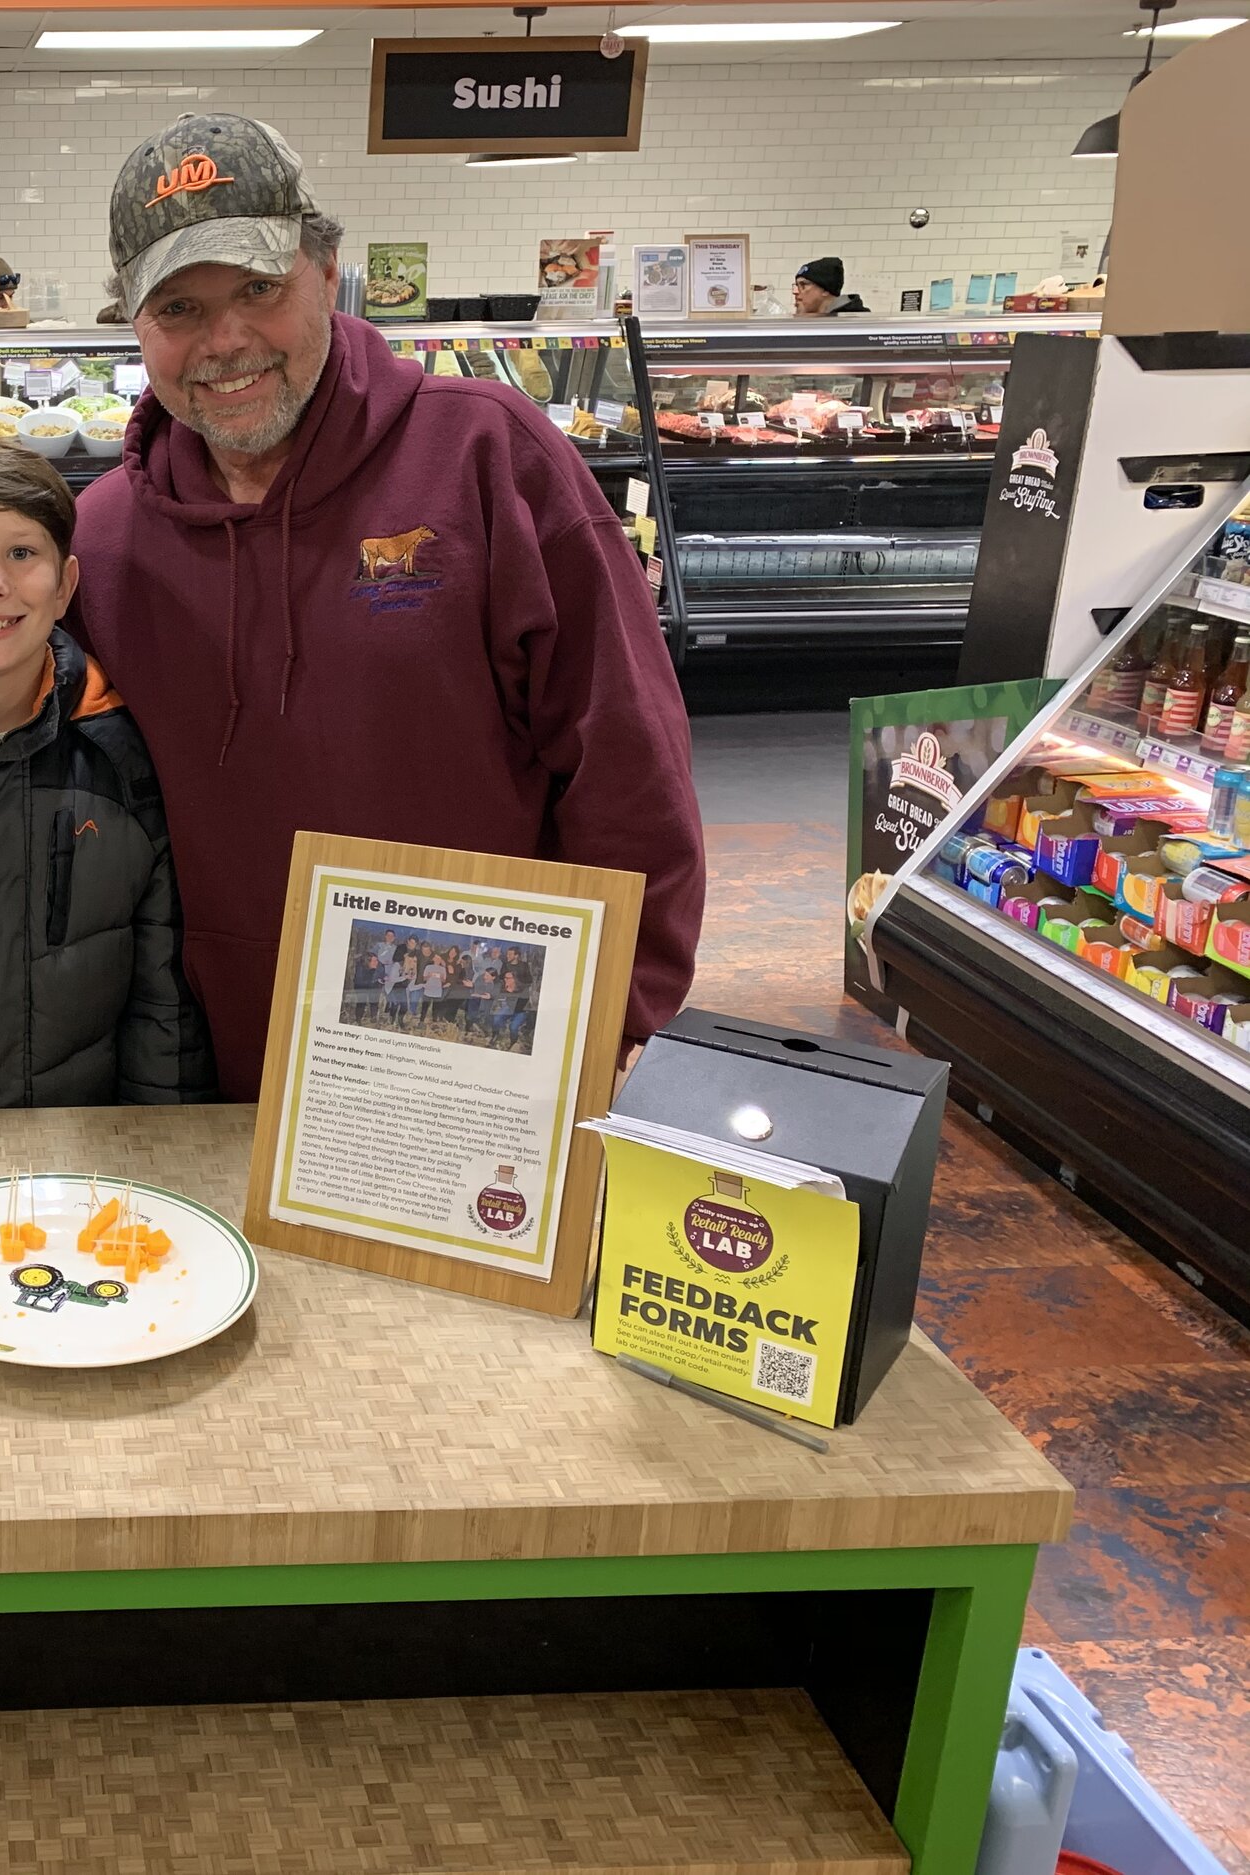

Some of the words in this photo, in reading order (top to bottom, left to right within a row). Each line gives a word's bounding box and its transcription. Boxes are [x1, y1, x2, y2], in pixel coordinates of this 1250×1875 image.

[452, 74, 562, 109] Sushi
[559, 292, 569, 300] ASK
[1019, 451, 1051, 463] BROWNBERRY
[1009, 474, 1024, 484] GREAT
[1025, 476, 1040, 487] BREAD
[1014, 487, 1060, 519] Stuffing
[901, 762, 951, 793] BROWNBERRY
[875, 813, 899, 833] Great
[888, 794, 909, 815] GREAT
[910, 802, 932, 827] BREAD
[333, 892, 380, 912] Little
[385, 899, 448, 922] Brown
[452, 909, 495, 929] Cow
[499, 915, 572, 939] Cheese
[315, 1026, 331, 1034] Who
[343, 1031, 361, 1041] they:
[364, 1034, 377, 1042] Don
[378, 1037, 390, 1045] and
[391, 1039, 407, 1049] Lynn
[407, 1042, 441, 1053] Wilterdink
[313, 1041, 334, 1050] Where
[348, 1047, 364, 1057] they
[364, 1049, 383, 1058] from:
[385, 1053, 417, 1066] Hingham,
[418, 1059, 452, 1071] Wisconsin
[698, 1207, 715, 1217] willy
[716, 1212, 737, 1223] street
[690, 1213, 727, 1235] Retail
[729, 1223, 768, 1251] Ready
[702, 1232, 752, 1259] LAB
[622, 1264, 819, 1346] FEEDBACK
[616, 1327, 631, 1337] See
[619, 1293, 749, 1353] FORMS
[615, 1336, 627, 1347] lab
[629, 1342, 637, 1350] or
[639, 1346, 657, 1357] scan
[659, 1351, 671, 1361] the
[672, 1355, 686, 1367] QR
[687, 1360, 710, 1374] code.
[617, 1317, 631, 1329] You
[633, 1323, 647, 1334] can
[648, 1327, 665, 1339] also
[666, 1333, 676, 1343] fill
[680, 1338, 691, 1348] out
[699, 1344, 718, 1357] form
[720, 1351, 749, 1367] online!
